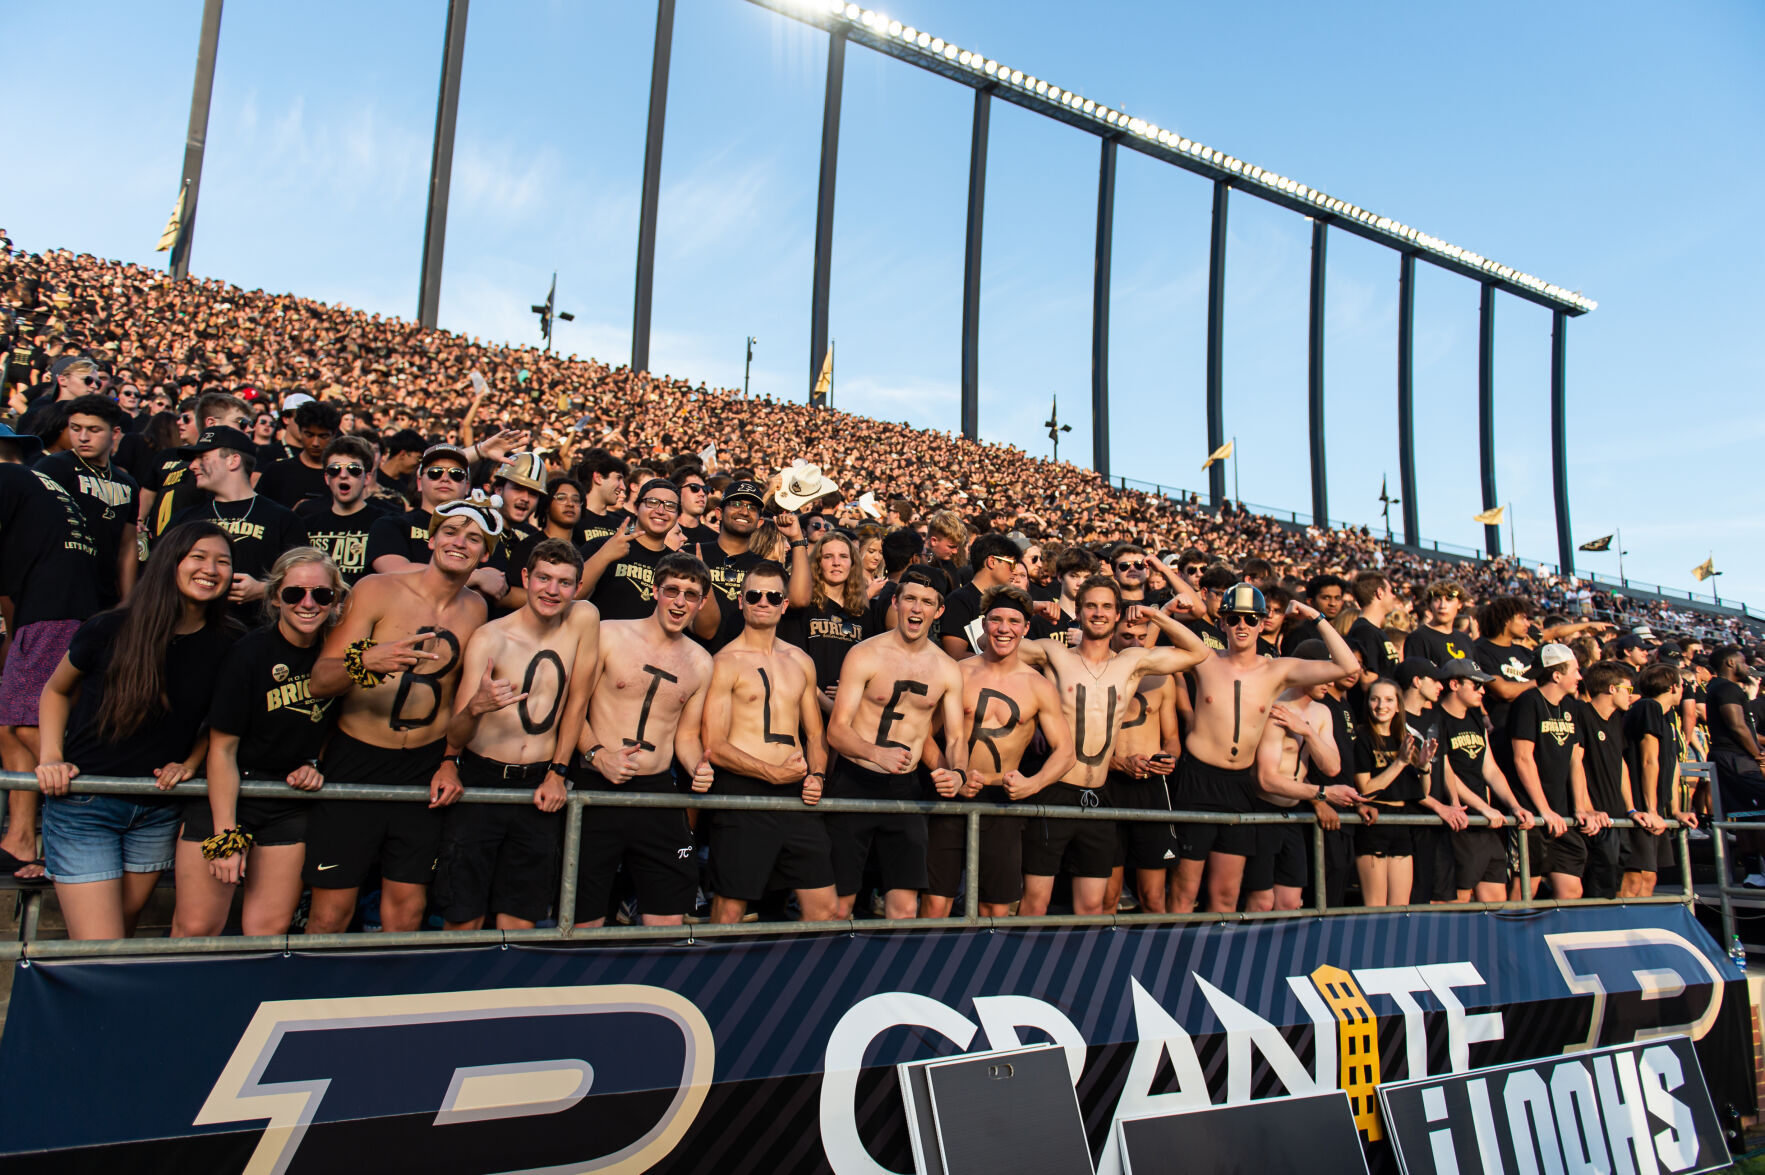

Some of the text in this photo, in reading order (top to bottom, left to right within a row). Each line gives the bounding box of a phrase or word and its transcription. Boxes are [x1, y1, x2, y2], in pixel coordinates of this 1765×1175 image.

[390, 626, 460, 732] B
[517, 650, 566, 735] O
[758, 667, 796, 747] L
[875, 680, 929, 751] E
[968, 687, 1021, 774] R
[1075, 683, 1117, 765] U
